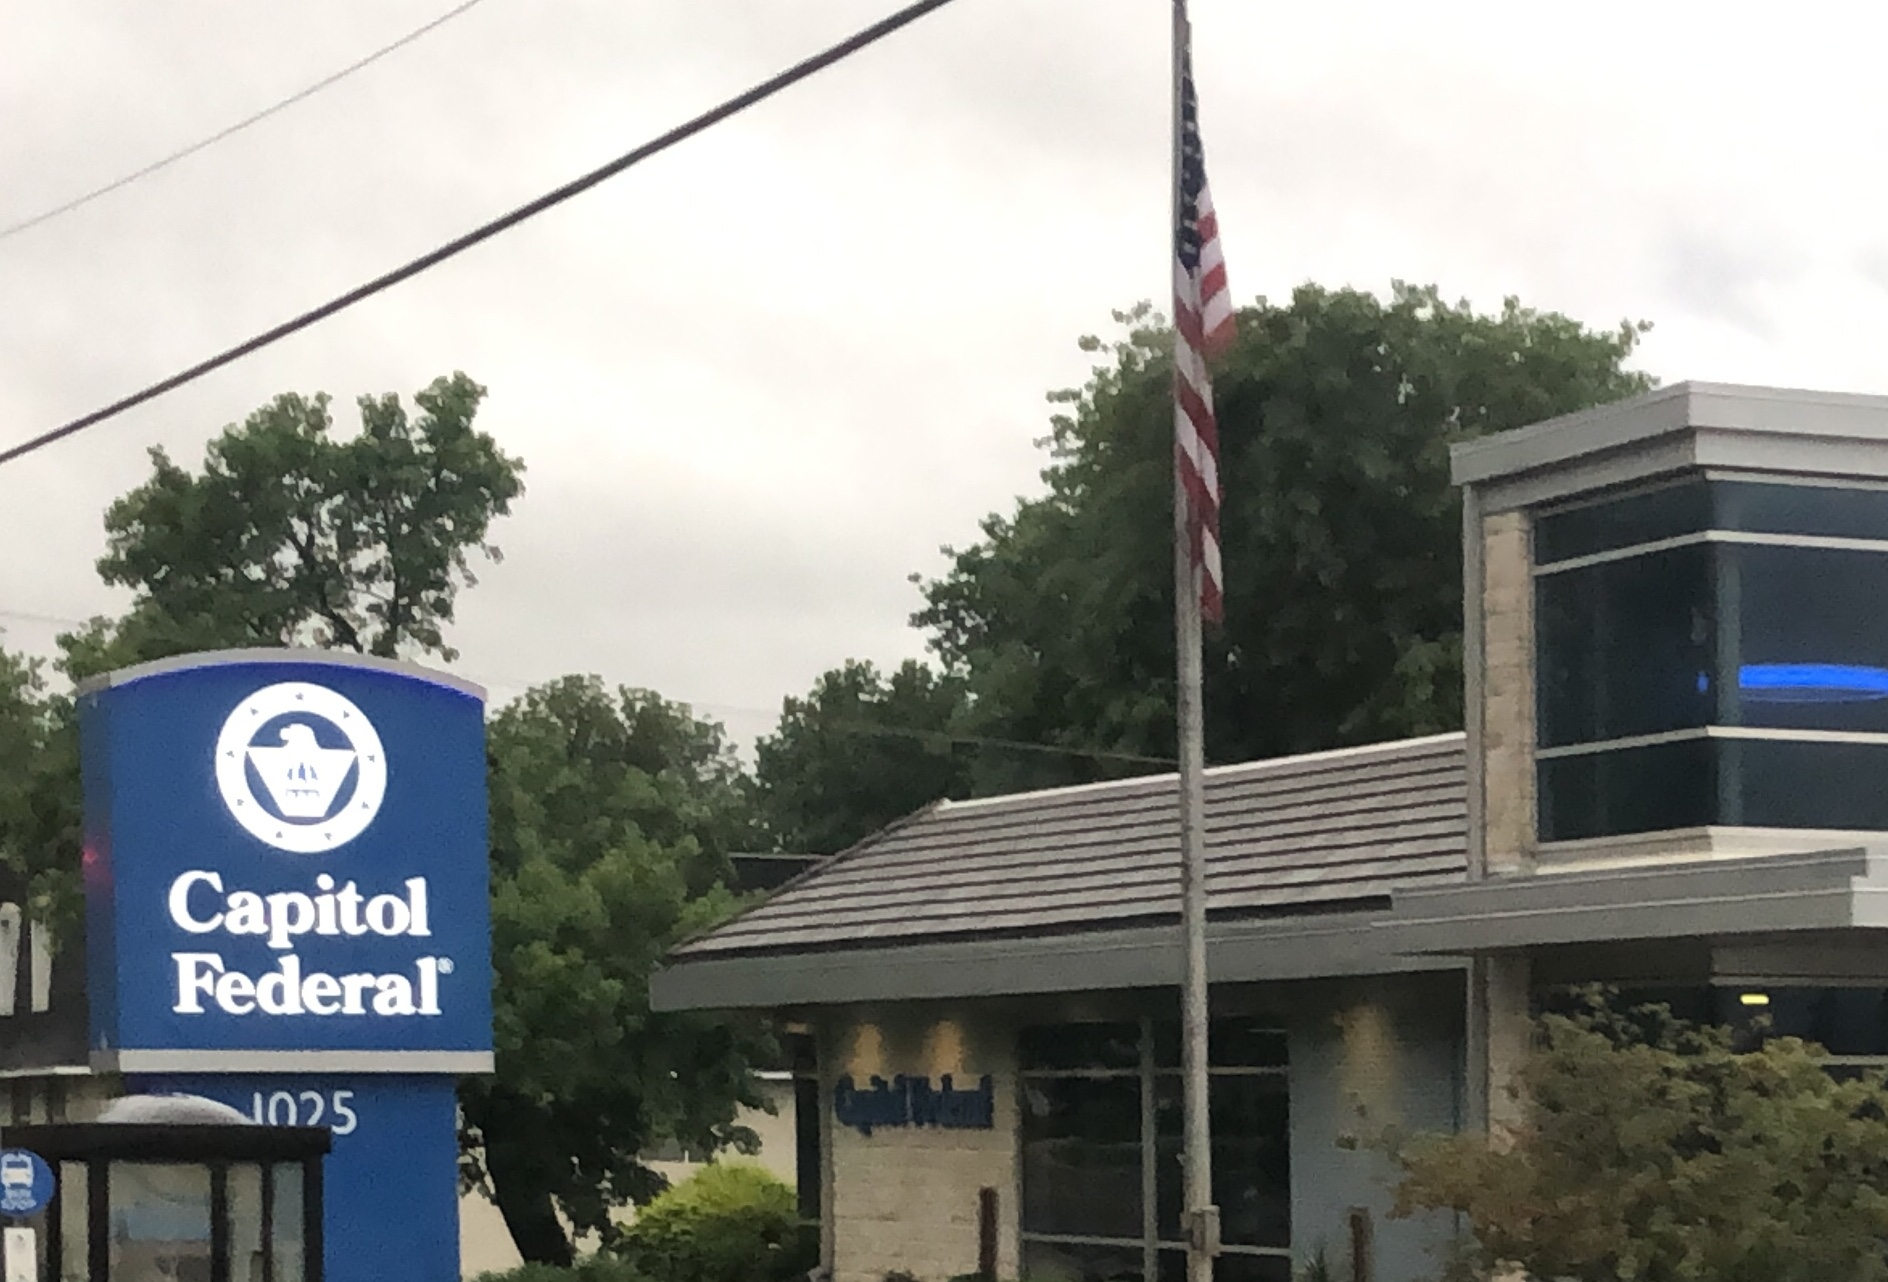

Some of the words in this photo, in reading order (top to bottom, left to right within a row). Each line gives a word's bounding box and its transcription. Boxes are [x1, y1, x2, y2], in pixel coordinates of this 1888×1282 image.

[168, 870, 432, 949] Capitol
[171, 952, 442, 1016] Federal
[253, 1090, 358, 1135] 1025
